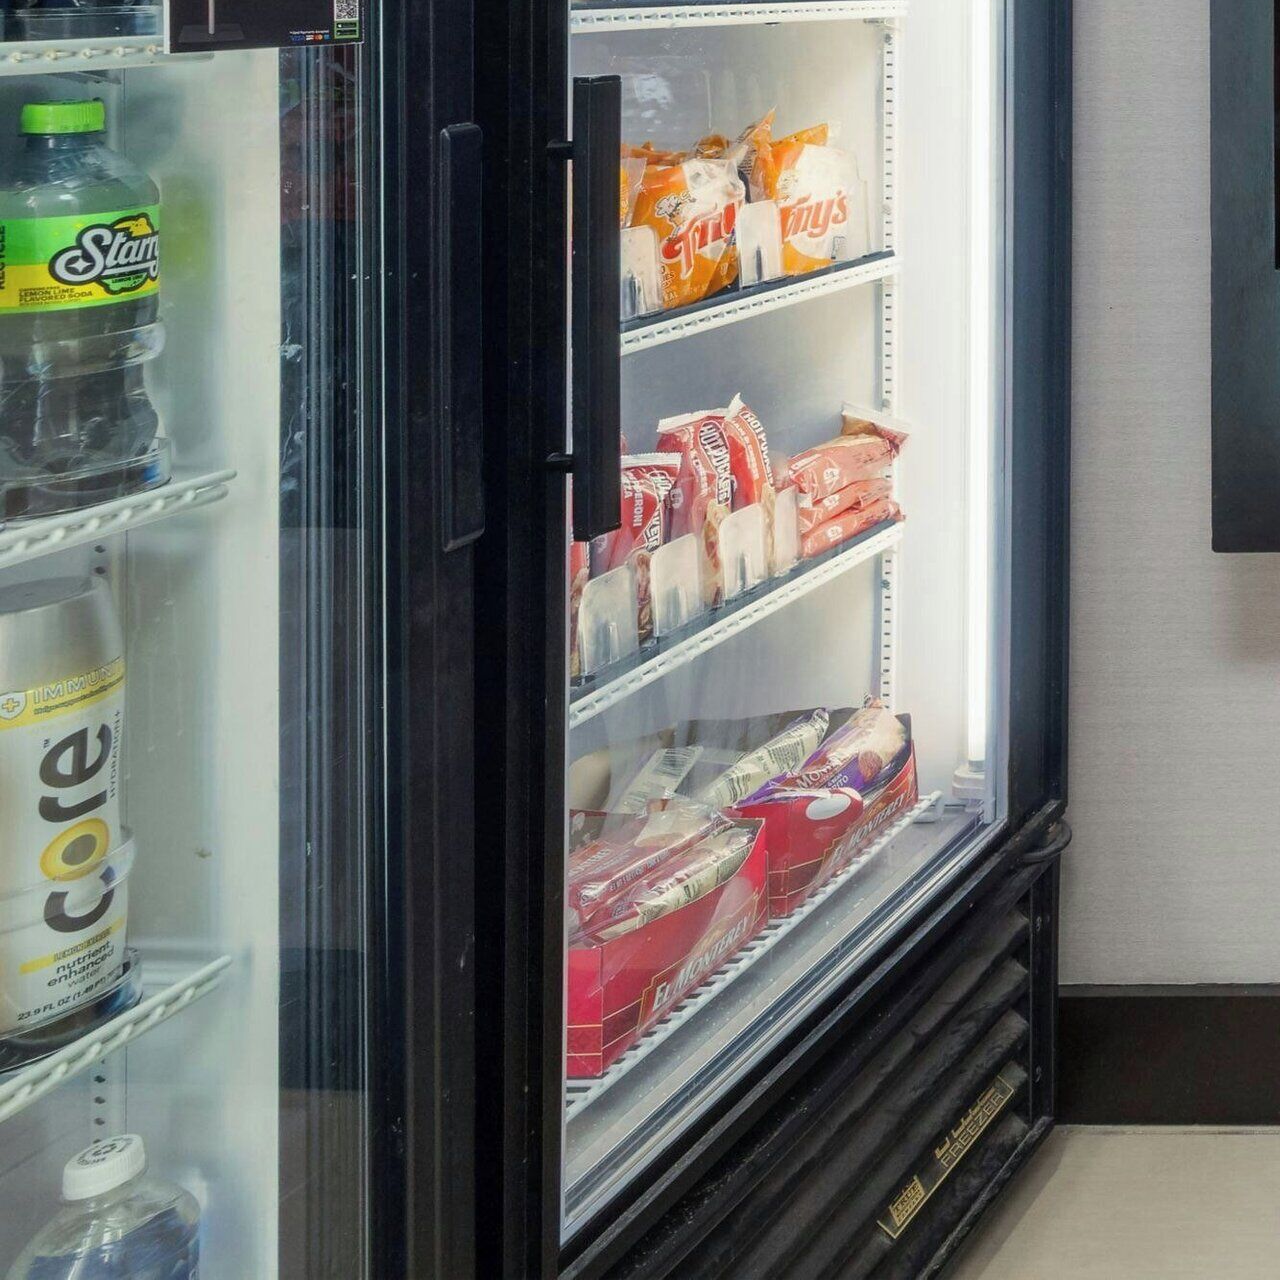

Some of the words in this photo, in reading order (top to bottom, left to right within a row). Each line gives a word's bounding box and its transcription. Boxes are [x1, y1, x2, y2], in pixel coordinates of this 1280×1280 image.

[19, 290, 52, 299] LEMON
[53, 287, 75, 295] LIME
[19, 294, 66, 304] FLAVORED
[67, 291, 93, 301] SODA
[38, 723, 116, 933] core
[47, 945, 115, 987] enhanced
[56, 939, 110, 974] nutrient
[940, 1091, 1004, 1168] FREEZER
